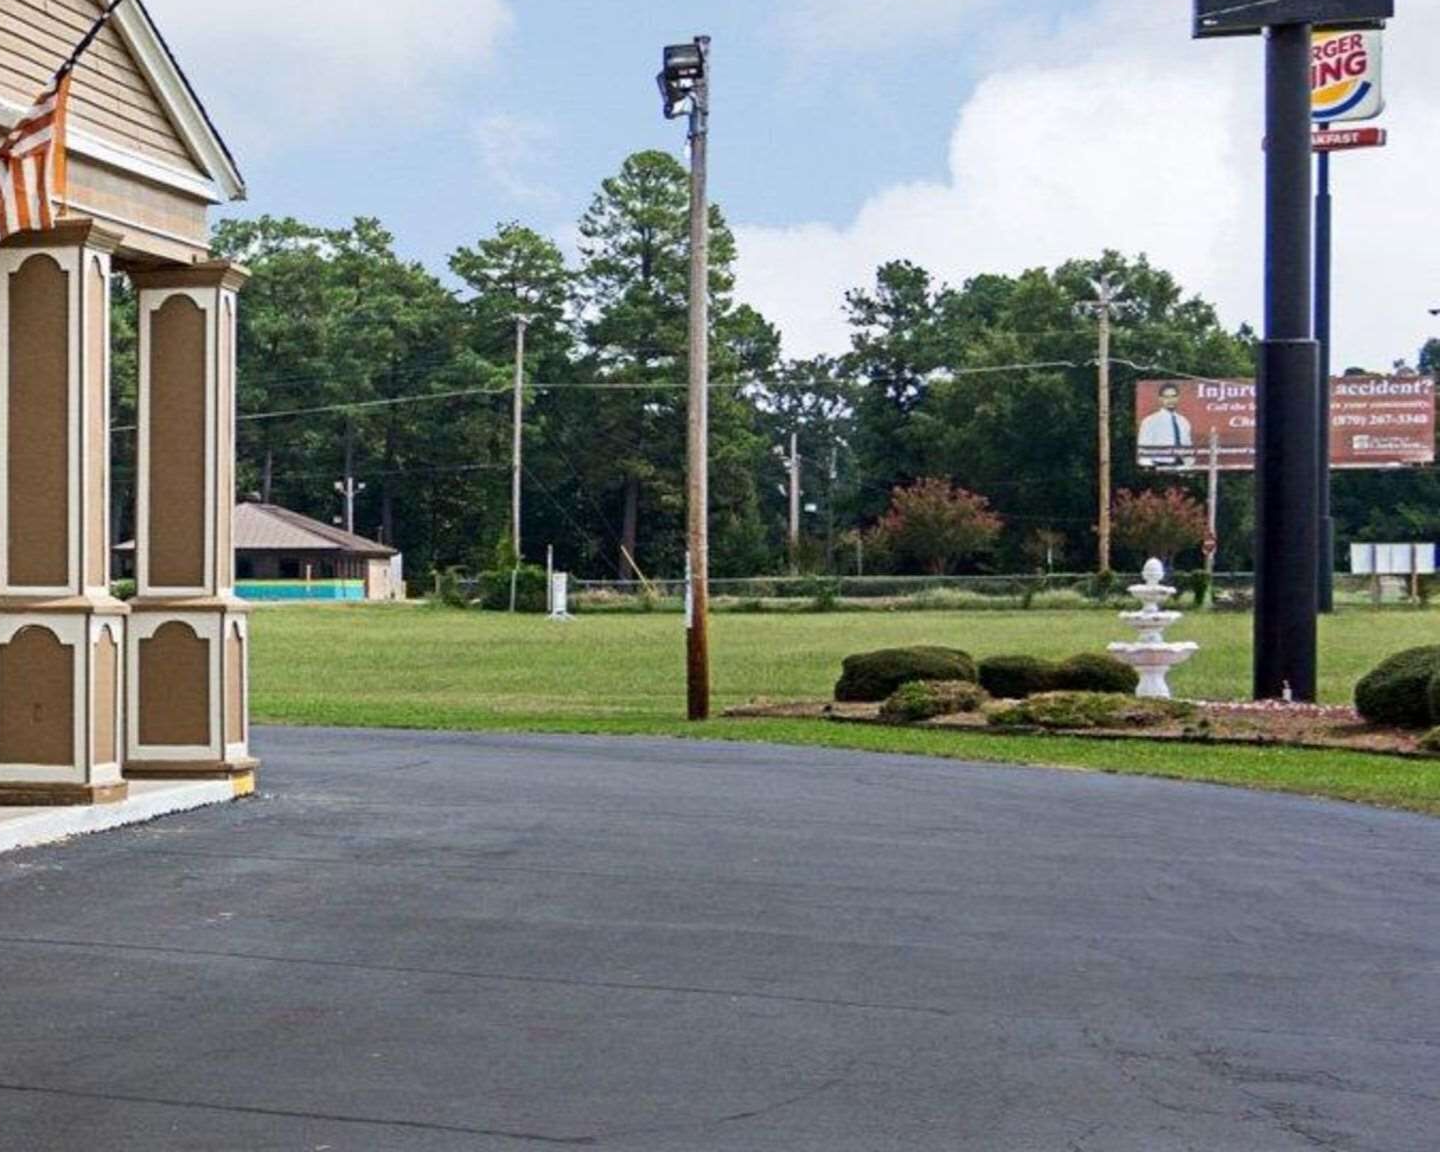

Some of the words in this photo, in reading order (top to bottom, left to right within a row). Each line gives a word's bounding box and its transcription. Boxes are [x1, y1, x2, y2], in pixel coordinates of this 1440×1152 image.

[1312, 33, 1363, 60] RGER
[1311, 51, 1367, 89] ING
[1335, 378, 1434, 396] accident?
